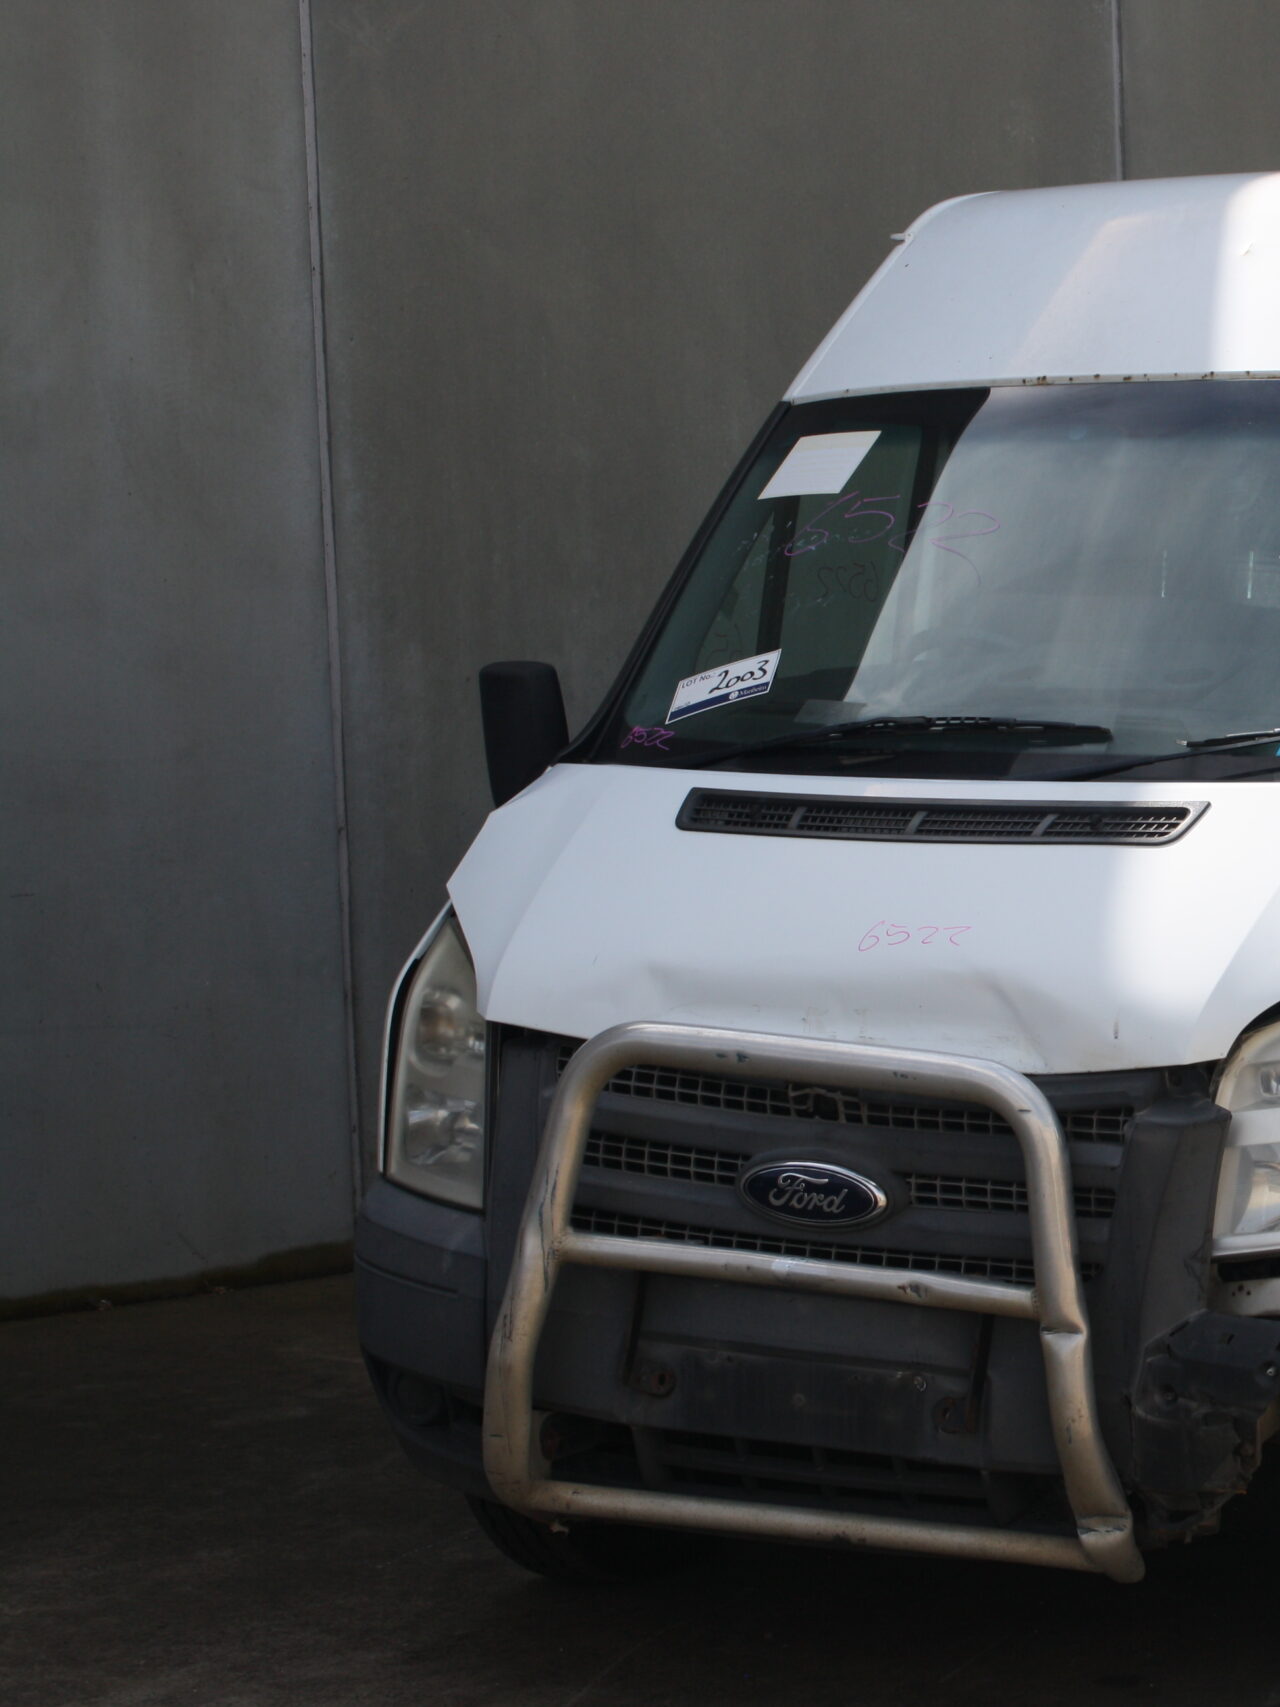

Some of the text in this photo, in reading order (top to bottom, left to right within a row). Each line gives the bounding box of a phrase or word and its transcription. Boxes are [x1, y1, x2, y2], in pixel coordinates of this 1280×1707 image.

[784, 490, 1002, 588] 6522
[681, 677, 698, 689] LOT
[708, 659, 770, 694] 2003
[857, 919, 973, 952] 6522
[768, 1172, 849, 1214] Ford
